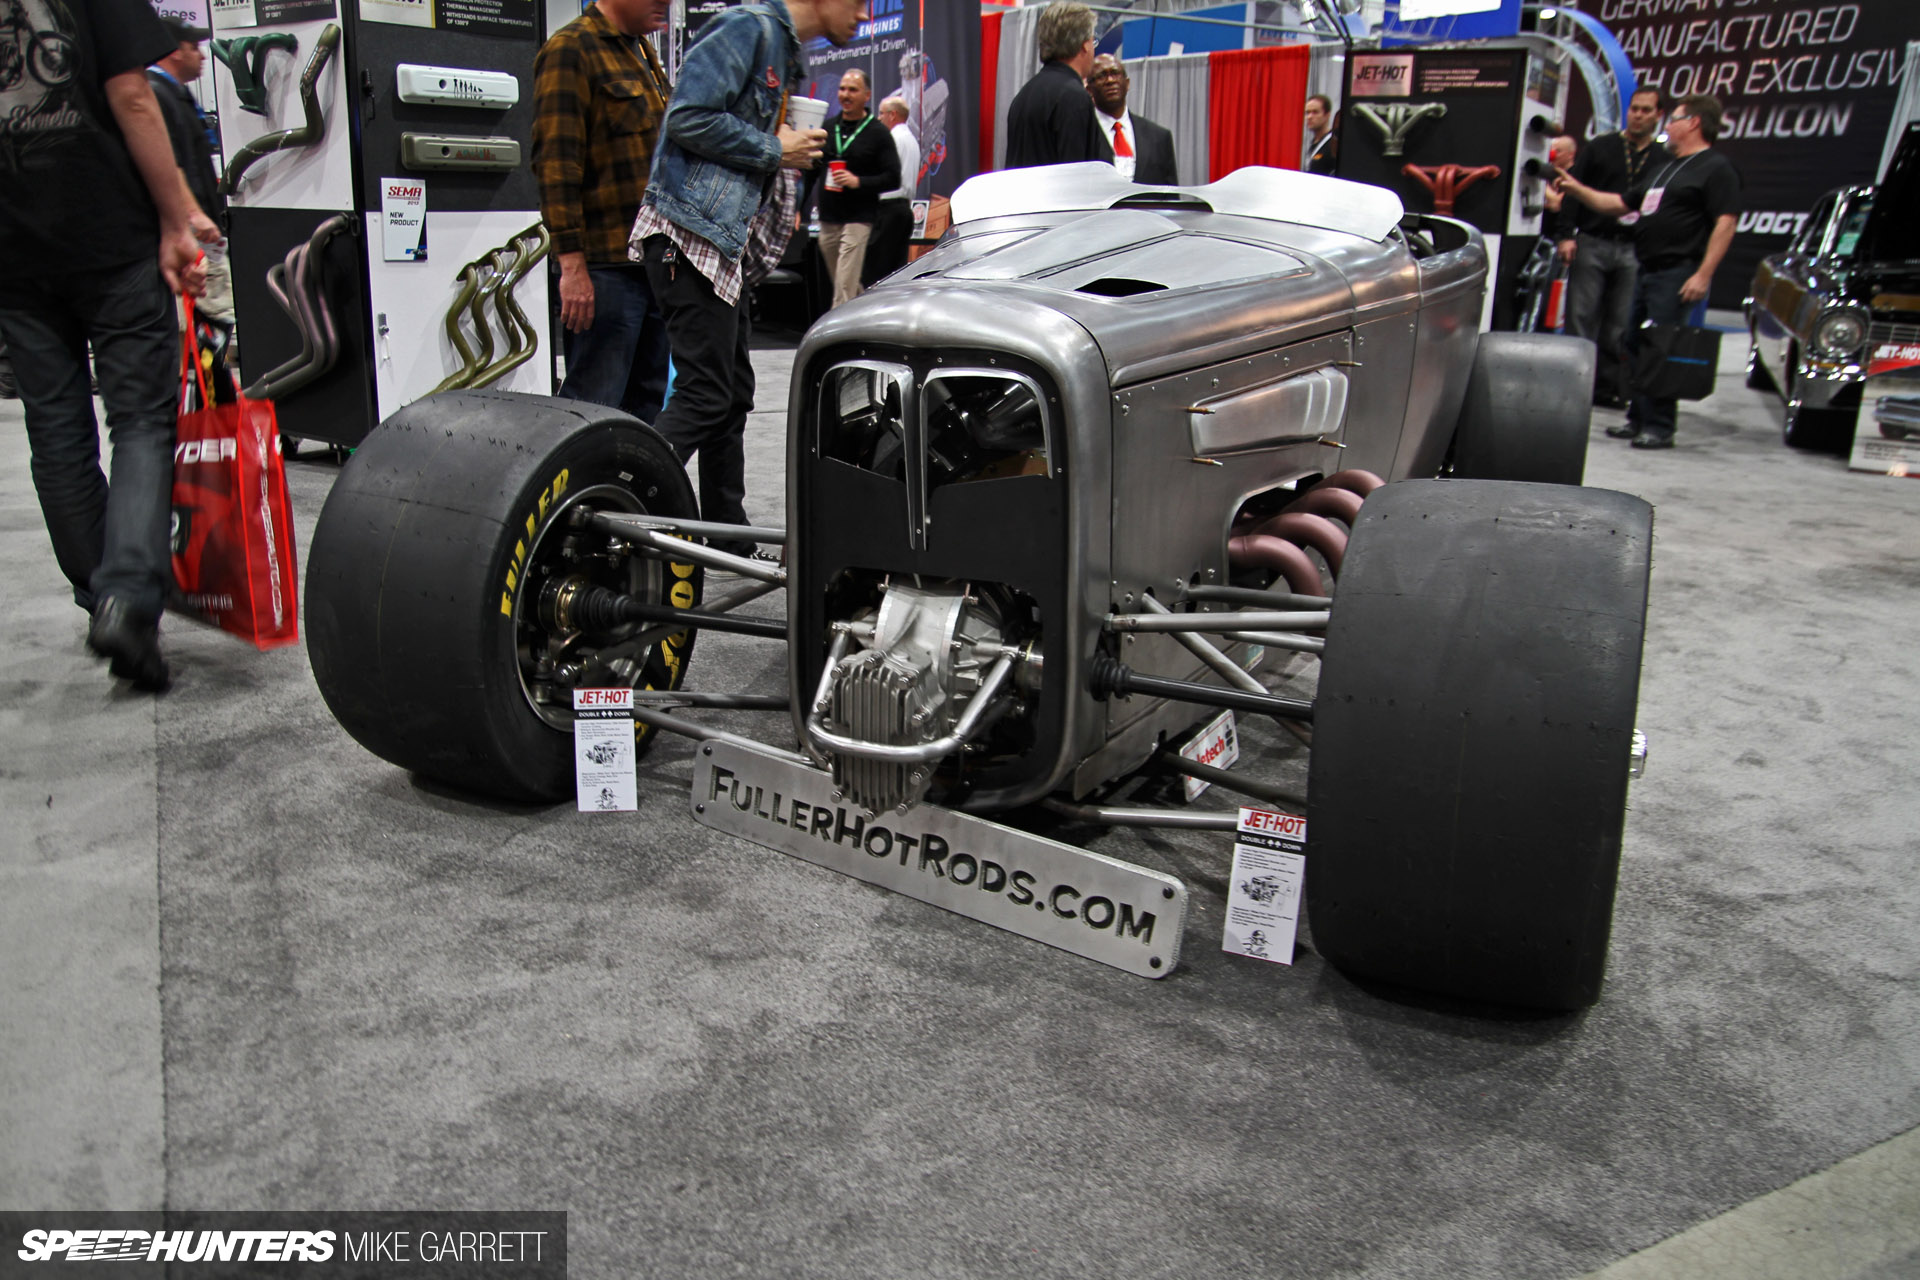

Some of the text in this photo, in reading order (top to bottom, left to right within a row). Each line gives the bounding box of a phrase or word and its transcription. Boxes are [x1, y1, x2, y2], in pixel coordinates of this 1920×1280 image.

[1600, 0, 1725, 21] GERM
[859, 17, 900, 37] ENGINES
[827, 45, 871, 61] Performance
[881, 38, 906, 53] Driven
[1356, 65, 1408, 81] JET-HOT
[1669, 61, 1741, 98] OUR
[1717, 102, 1853, 140] SILICON
[388, 186, 422, 197] SEMA
[1736, 212, 1809, 234] VOGT
[501, 468, 569, 619] FULLER
[579, 691, 630, 704] JET-HOT
[1244, 811, 1307, 835] JET-HOT
